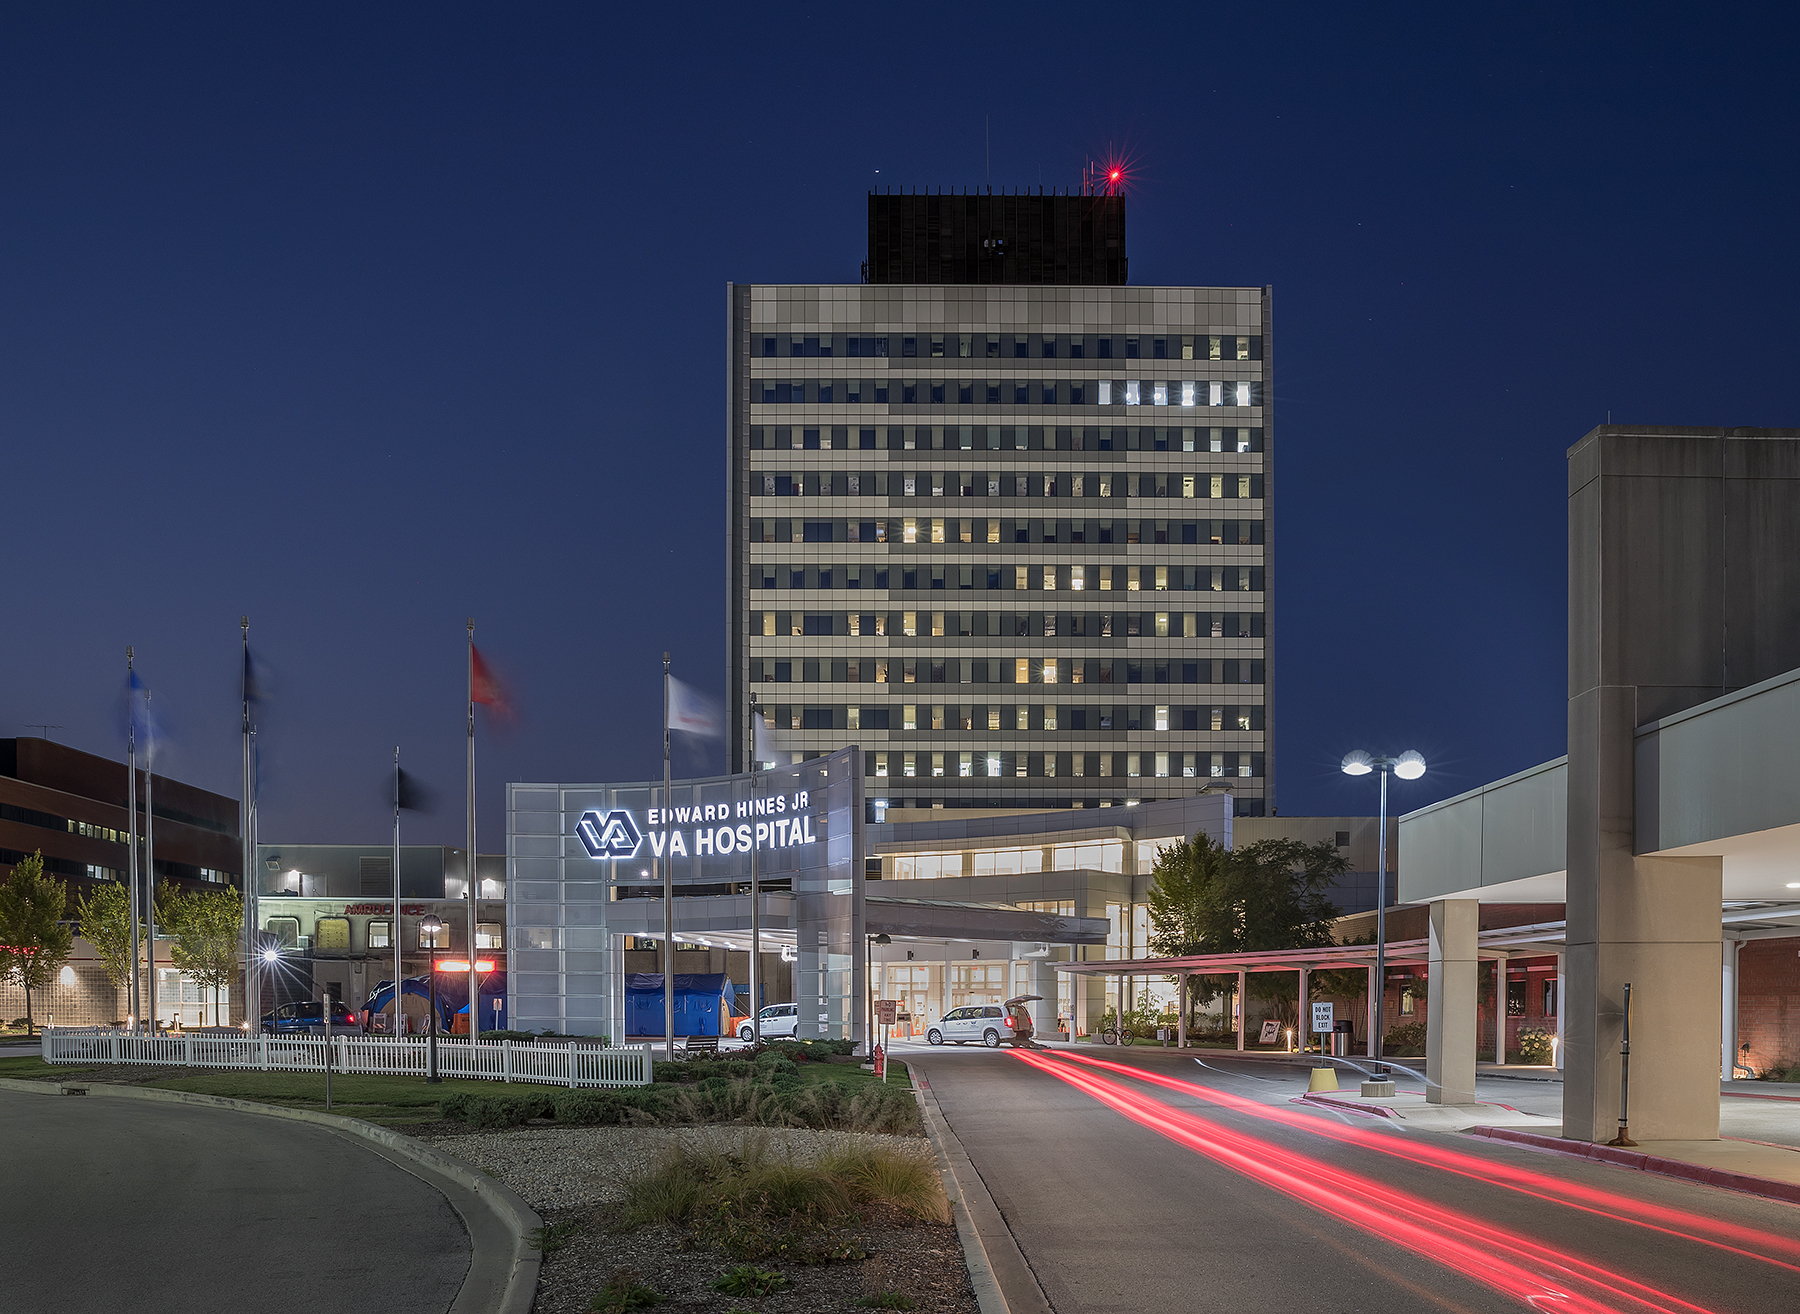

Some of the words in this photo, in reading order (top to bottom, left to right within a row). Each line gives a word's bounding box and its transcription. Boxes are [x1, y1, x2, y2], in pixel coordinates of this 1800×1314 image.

[647, 803, 730, 825] EDWARD
[736, 795, 786, 818] HINES
[791, 790, 809, 811] JR
[648, 830, 688, 857] VA
[695, 815, 816, 856] HOSPITAL
